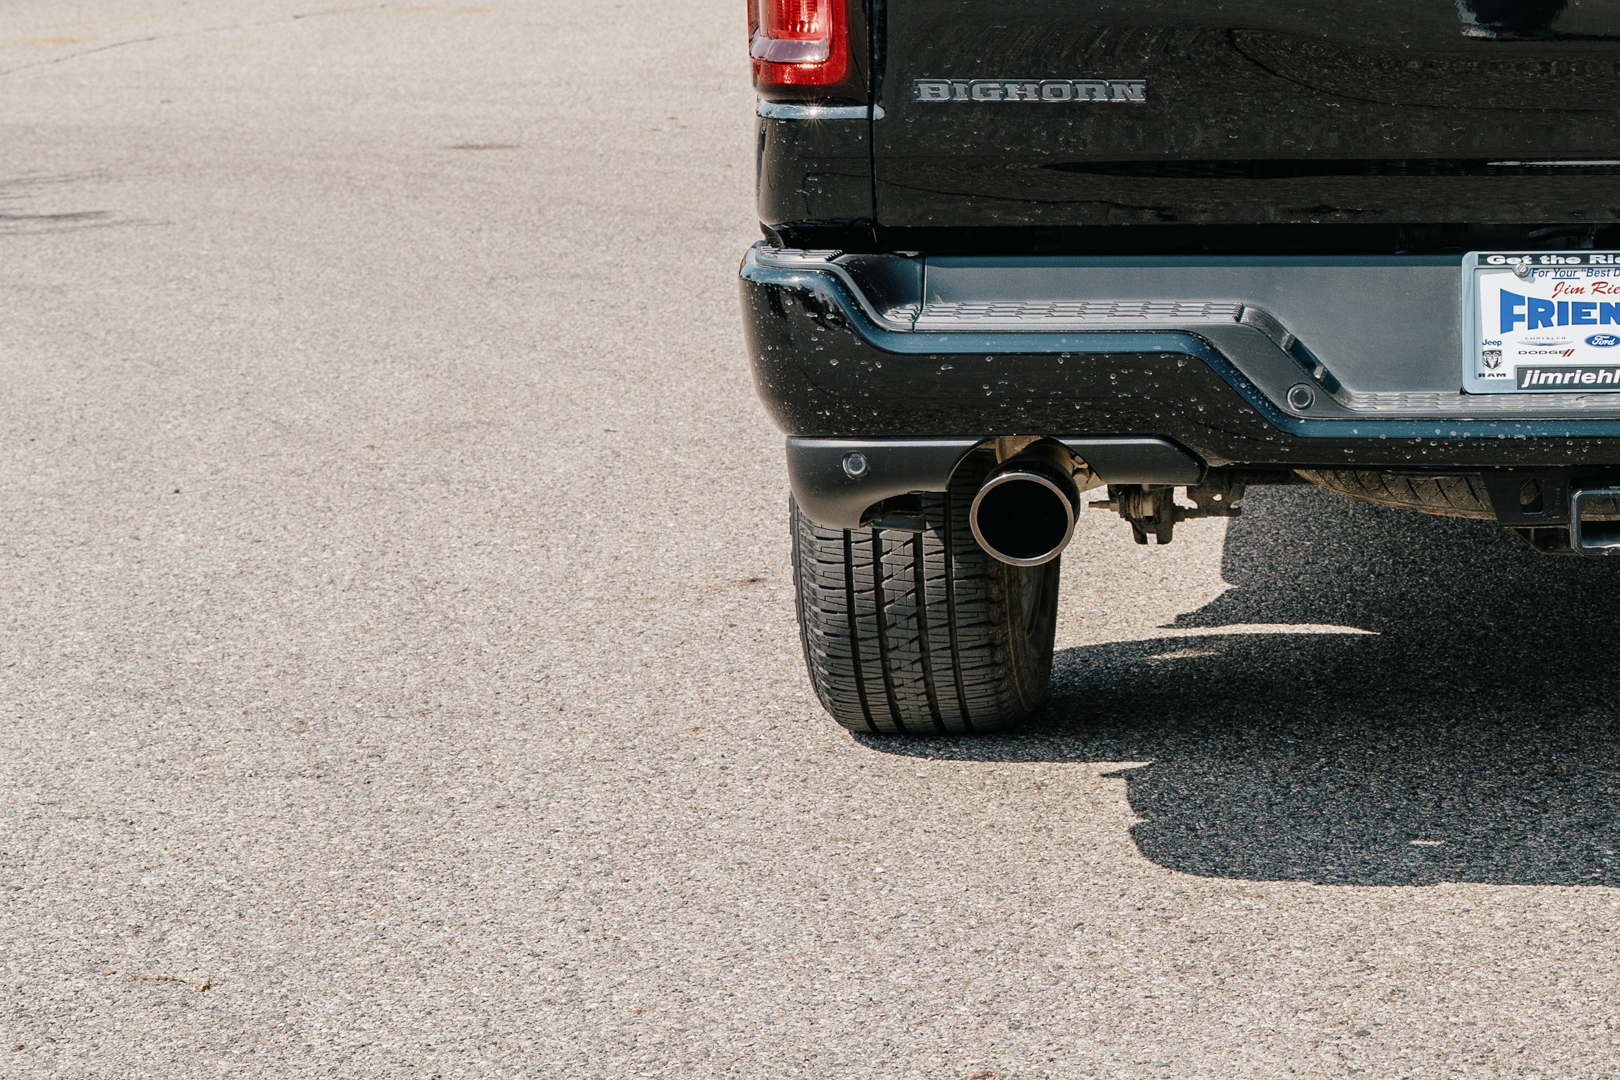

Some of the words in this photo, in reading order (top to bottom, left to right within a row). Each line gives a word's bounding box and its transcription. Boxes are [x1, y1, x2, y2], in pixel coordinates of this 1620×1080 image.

[913, 78, 1147, 103] BIGHORN
[1486, 254, 1533, 265] Get
[1539, 254, 1582, 265] the
[1531, 269, 1550, 278] For
[1553, 268, 1577, 279] Your
[1551, 281, 1586, 299] Jim
[1482, 338, 1503, 347] Jeep
[1591, 334, 1617, 346] Ford
